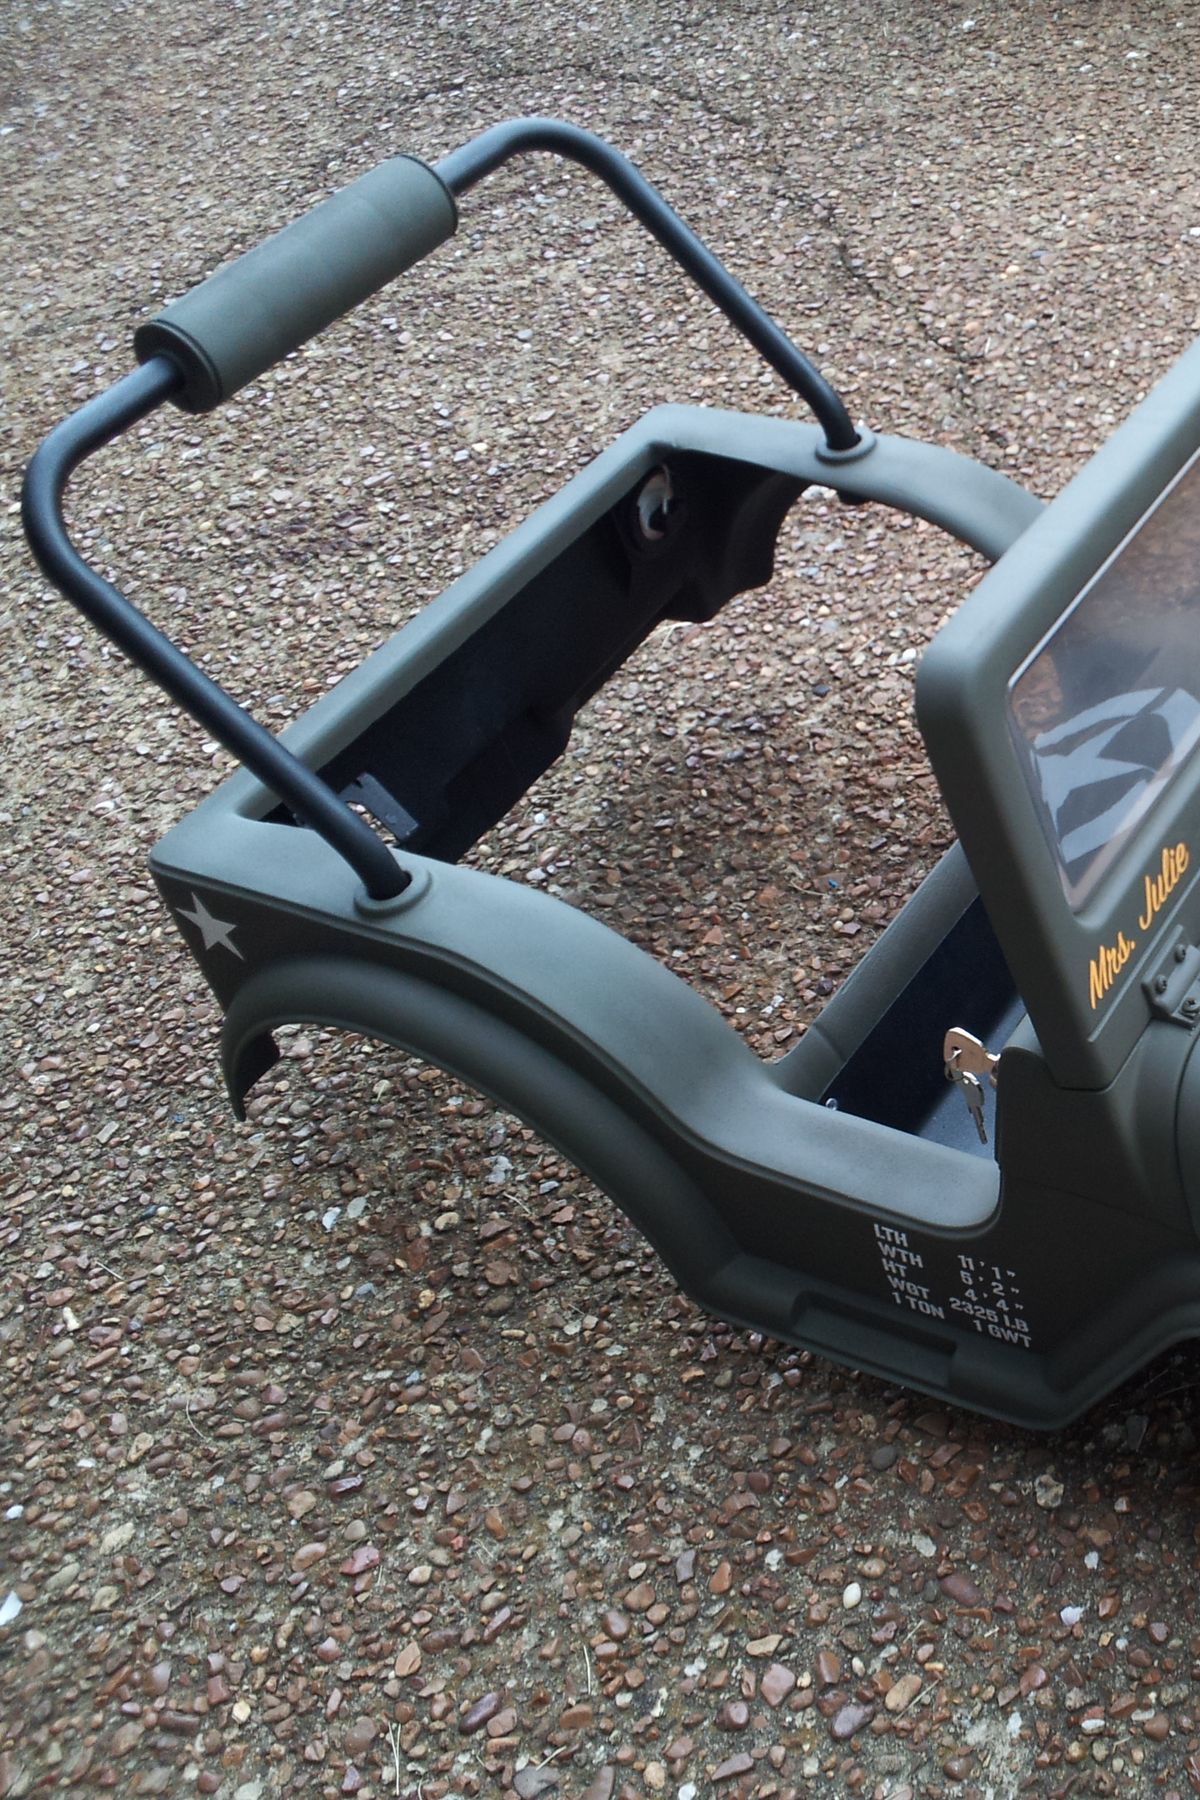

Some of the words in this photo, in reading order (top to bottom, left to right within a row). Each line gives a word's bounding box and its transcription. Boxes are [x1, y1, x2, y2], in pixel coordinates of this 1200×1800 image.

[1088, 931, 1136, 1009] Mrs.
[1138, 842, 1190, 930] Julie
[873, 1223, 908, 1247] LTH
[877, 1241, 924, 1268] WTH
[881, 1258, 907, 1277] HT
[887, 1274, 930, 1299] WGT
[949, 1297, 999, 1323] 2325
[891, 1291, 901, 1304] 1
[905, 1295, 945, 1320] TON
[973, 1319, 983, 1332] 1
[988, 1324, 1032, 1348] GWT
